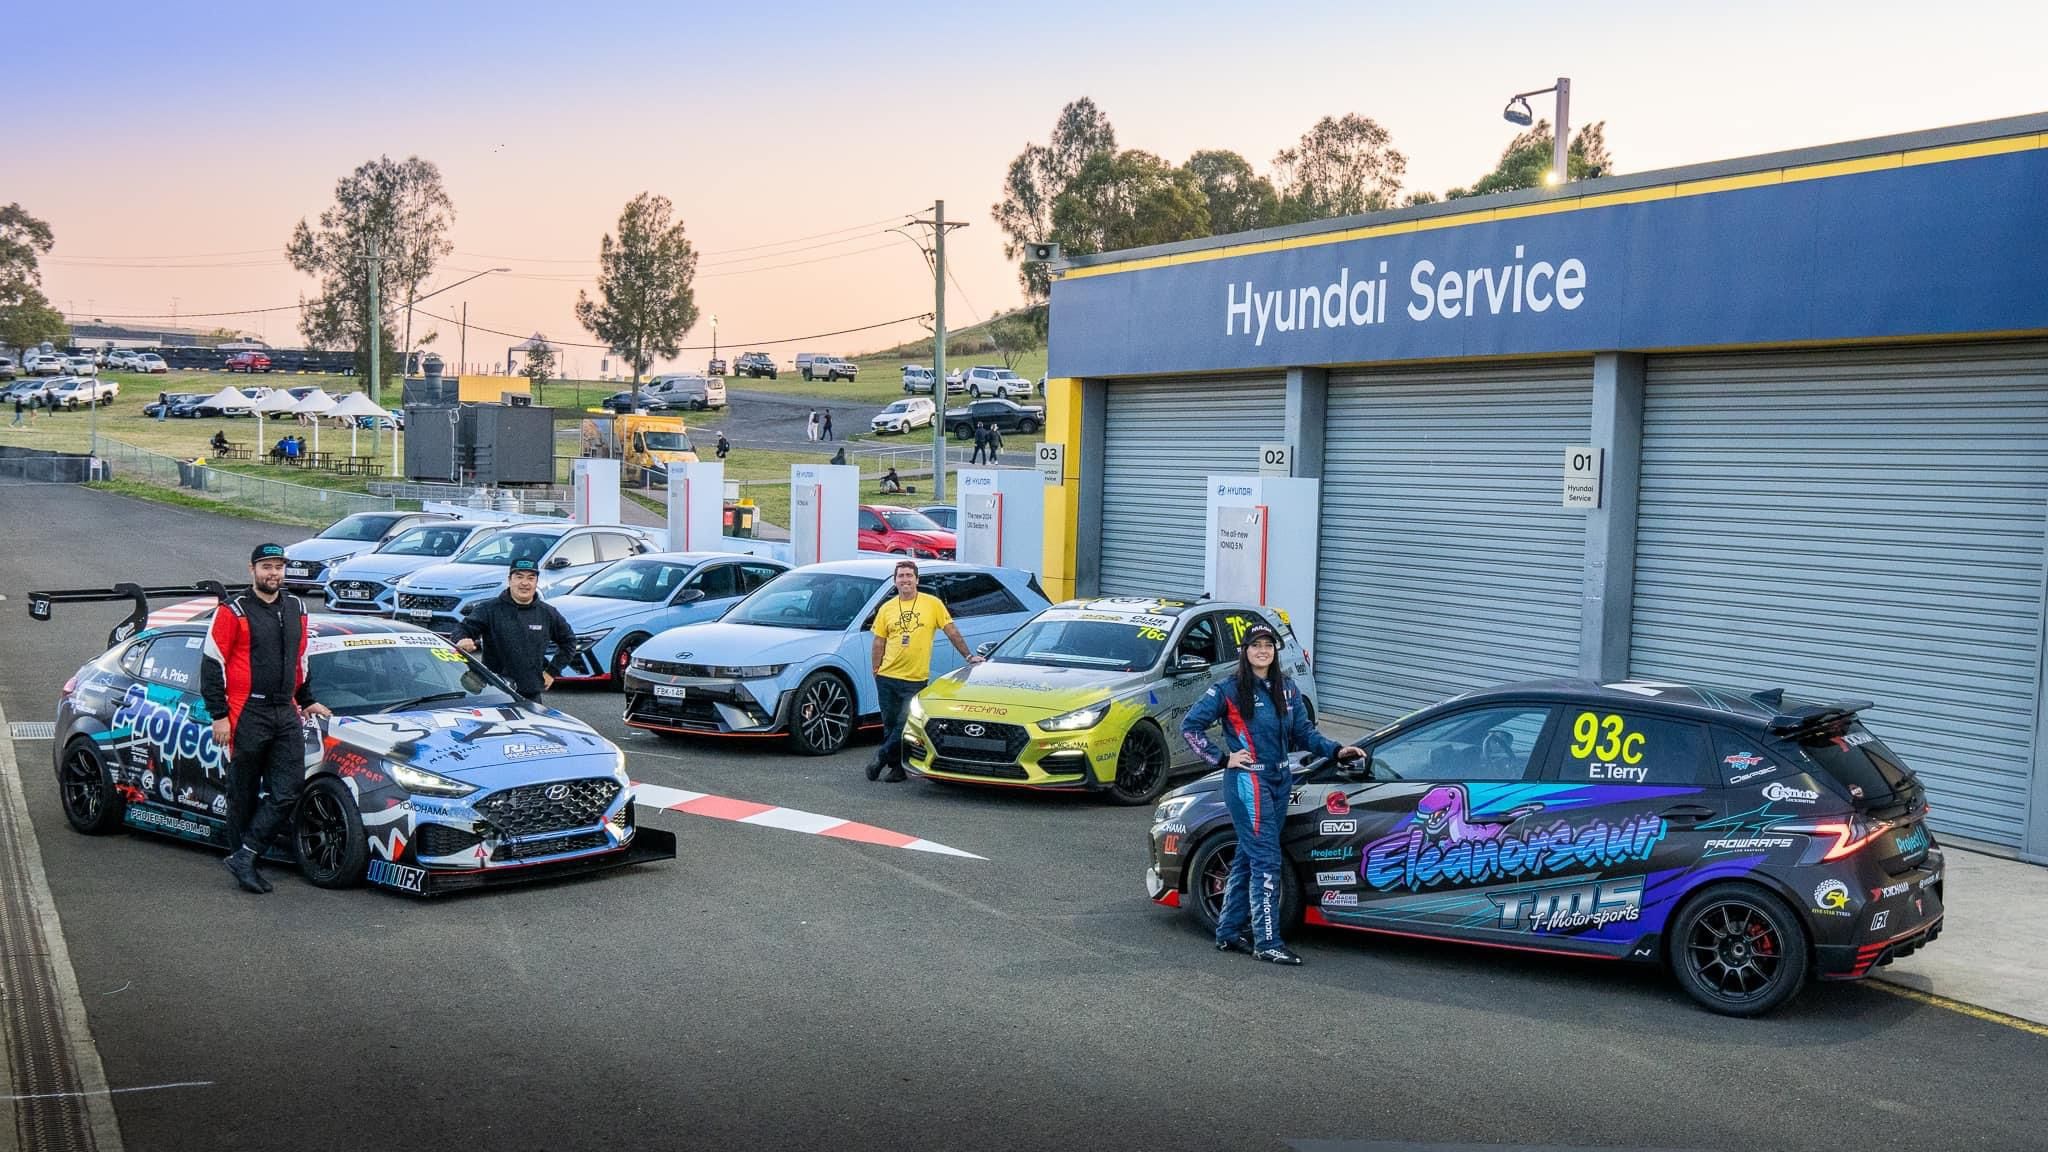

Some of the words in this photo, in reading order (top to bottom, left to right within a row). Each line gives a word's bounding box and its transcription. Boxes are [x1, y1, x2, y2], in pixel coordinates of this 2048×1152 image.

[1226, 261, 1388, 346] Hyundai
[1407, 245, 1586, 321] Service
[1040, 448, 1057, 460] 03
[1265, 450, 1285, 464] 02
[1573, 454, 1592, 471] 01
[1227, 486, 1253, 496] HYUNDAI
[1567, 484, 1594, 493] Hyundai
[1568, 494, 1592, 502] Service
[1220, 529, 1229, 538] The
[1230, 530, 1249, 539] all-new
[1136, 626, 1167, 641] 76c
[169, 671, 189, 684] Price
[112, 683, 222, 768] Projec
[1570, 712, 1646, 765] 93c
[1589, 763, 1648, 783] E.Terry
[400, 802, 449, 816] YOKOHAMA
[1704, 839, 1794, 849] PROWRAPS
[1311, 848, 1341, 858] Project
[1363, 814, 1666, 890] Eleanorsaur
[1882, 881, 1910, 898] YOKOHAMA
[1486, 874, 1647, 929] TMS
[1529, 904, 1639, 931] T-Motorsports
